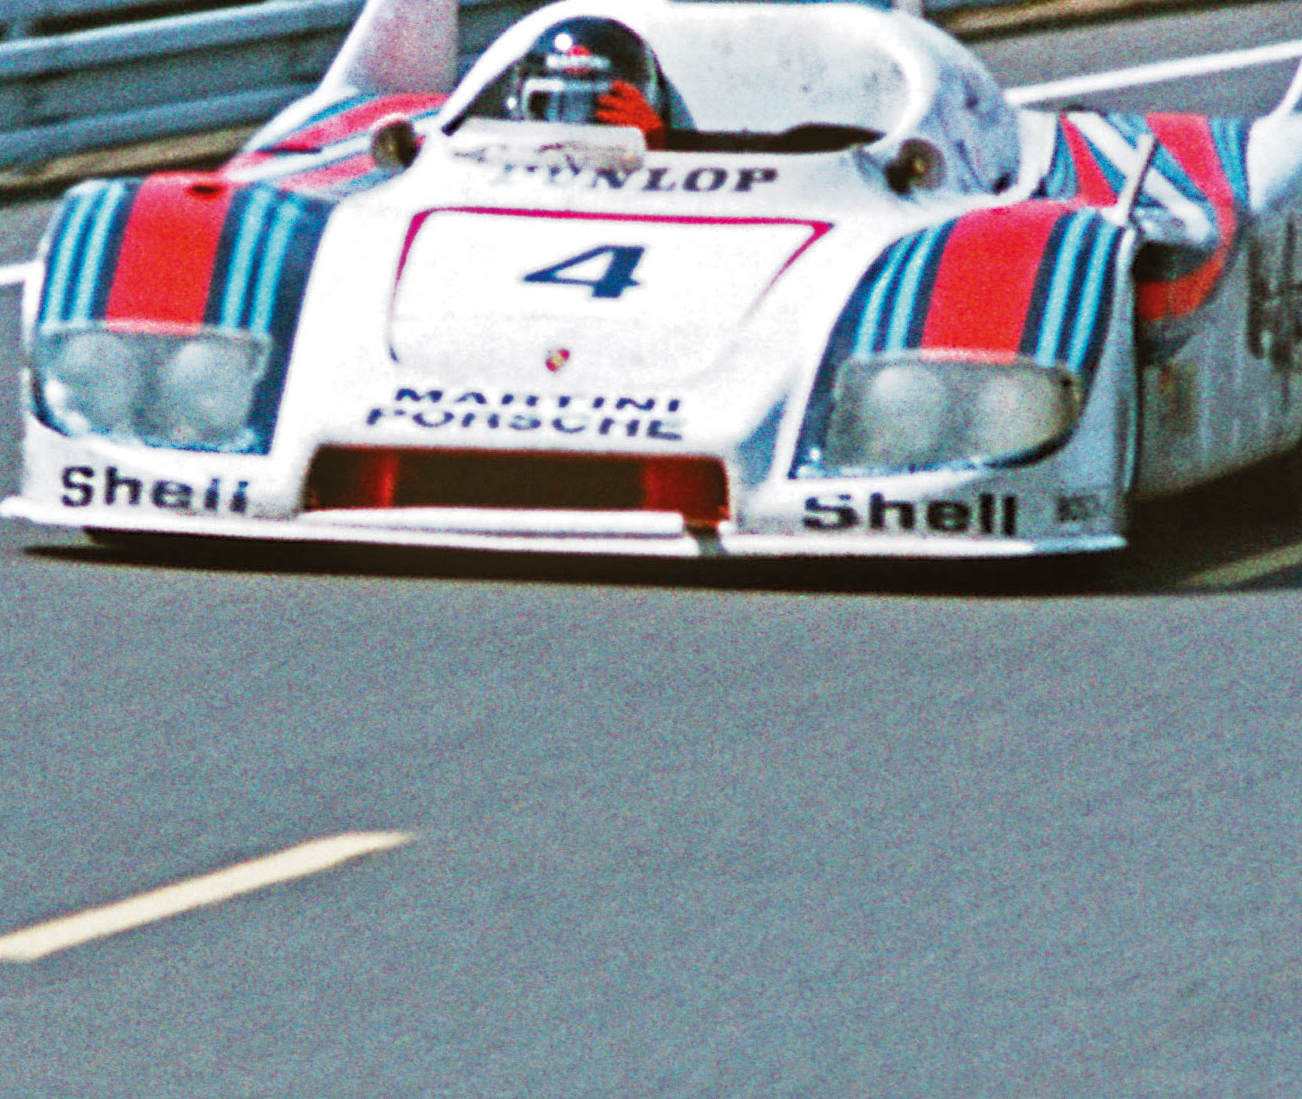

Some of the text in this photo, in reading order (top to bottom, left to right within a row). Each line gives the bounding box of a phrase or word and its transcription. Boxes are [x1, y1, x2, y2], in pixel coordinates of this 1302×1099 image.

[523, 245, 645, 299] 4
[395, 388, 681, 413] MARTINI
[365, 408, 683, 441] PORSCHE
[60, 465, 249, 514] Shell
[802, 492, 1017, 537] Shell
